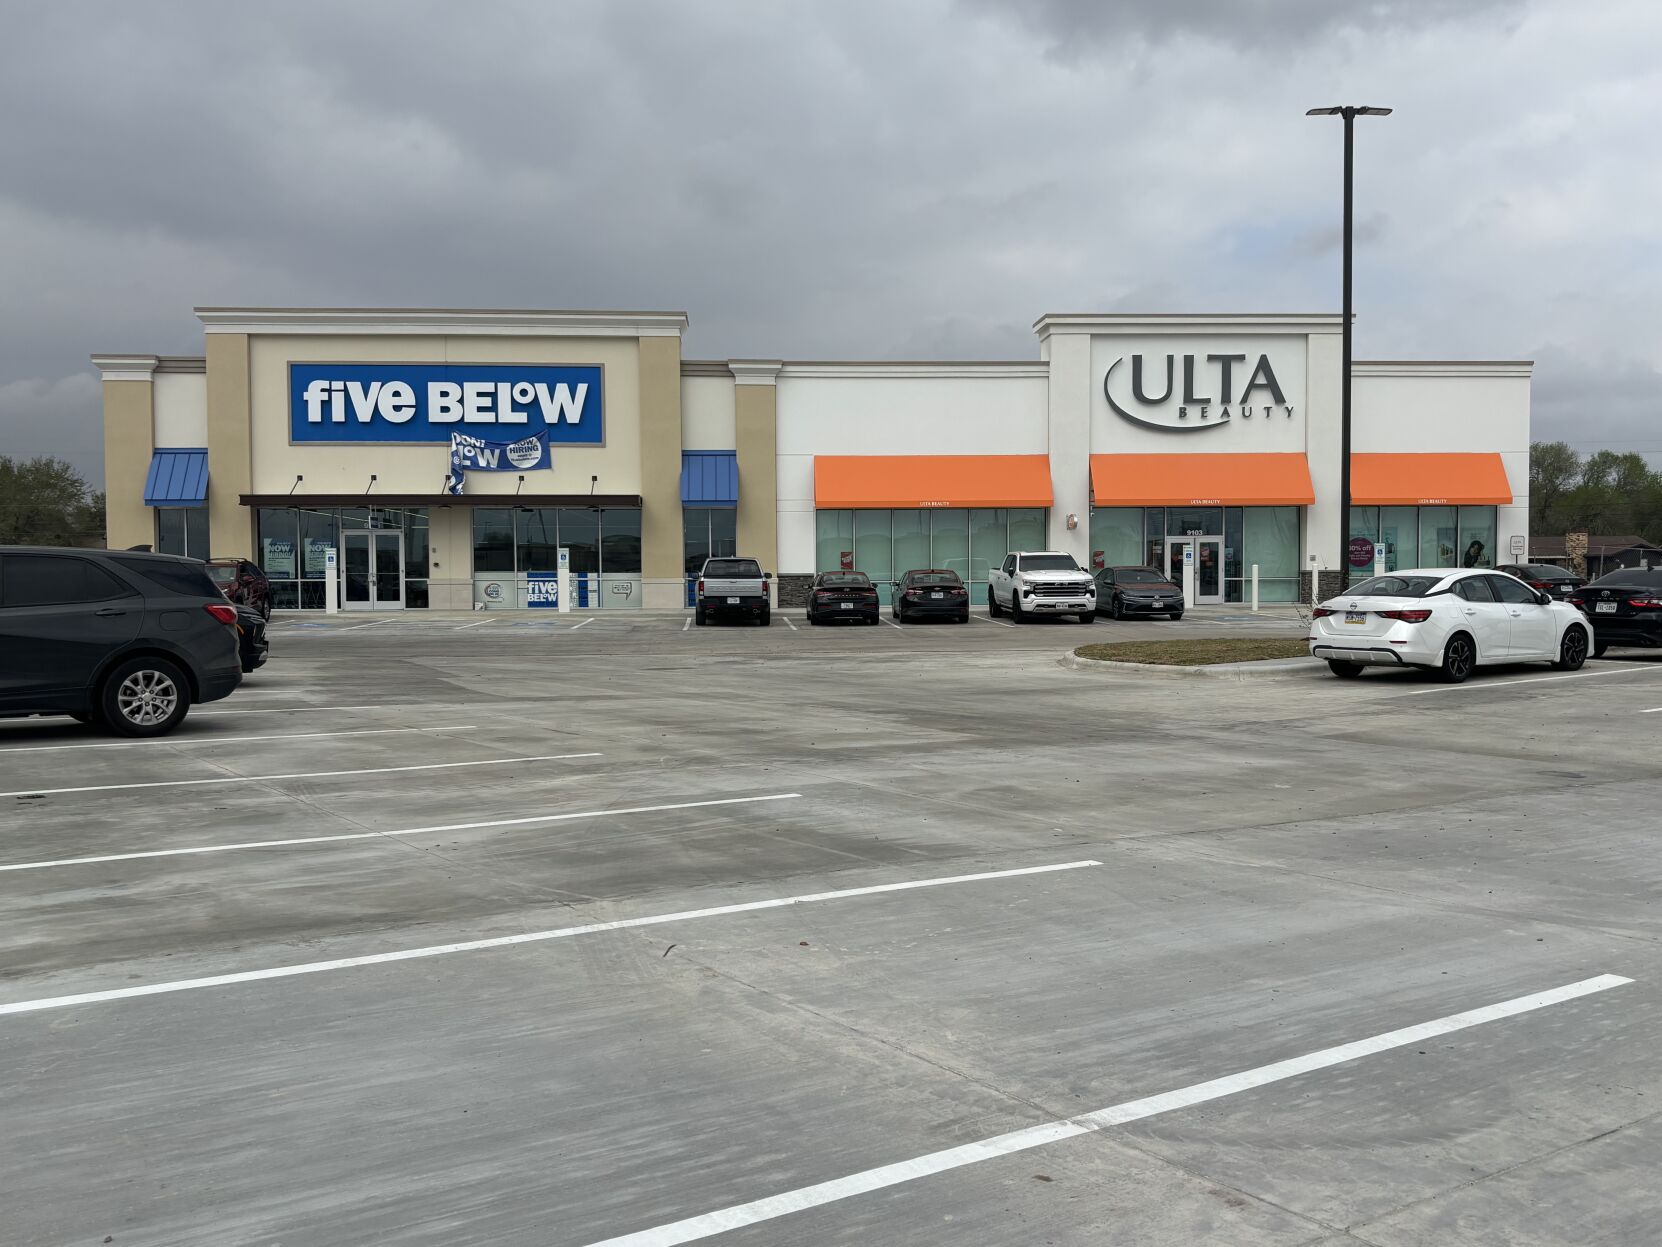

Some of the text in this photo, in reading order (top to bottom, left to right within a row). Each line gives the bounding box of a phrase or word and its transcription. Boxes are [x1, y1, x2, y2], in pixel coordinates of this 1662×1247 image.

[1132, 354, 1287, 405] ULTA
[303, 379, 589, 424] five BELOW
[1179, 406, 1294, 418] BEAUTY
[509, 444, 539, 454] HIRING
[268, 544, 291, 552] NOW
[527, 581, 558, 594] five
[527, 593, 558, 602] BELOW
